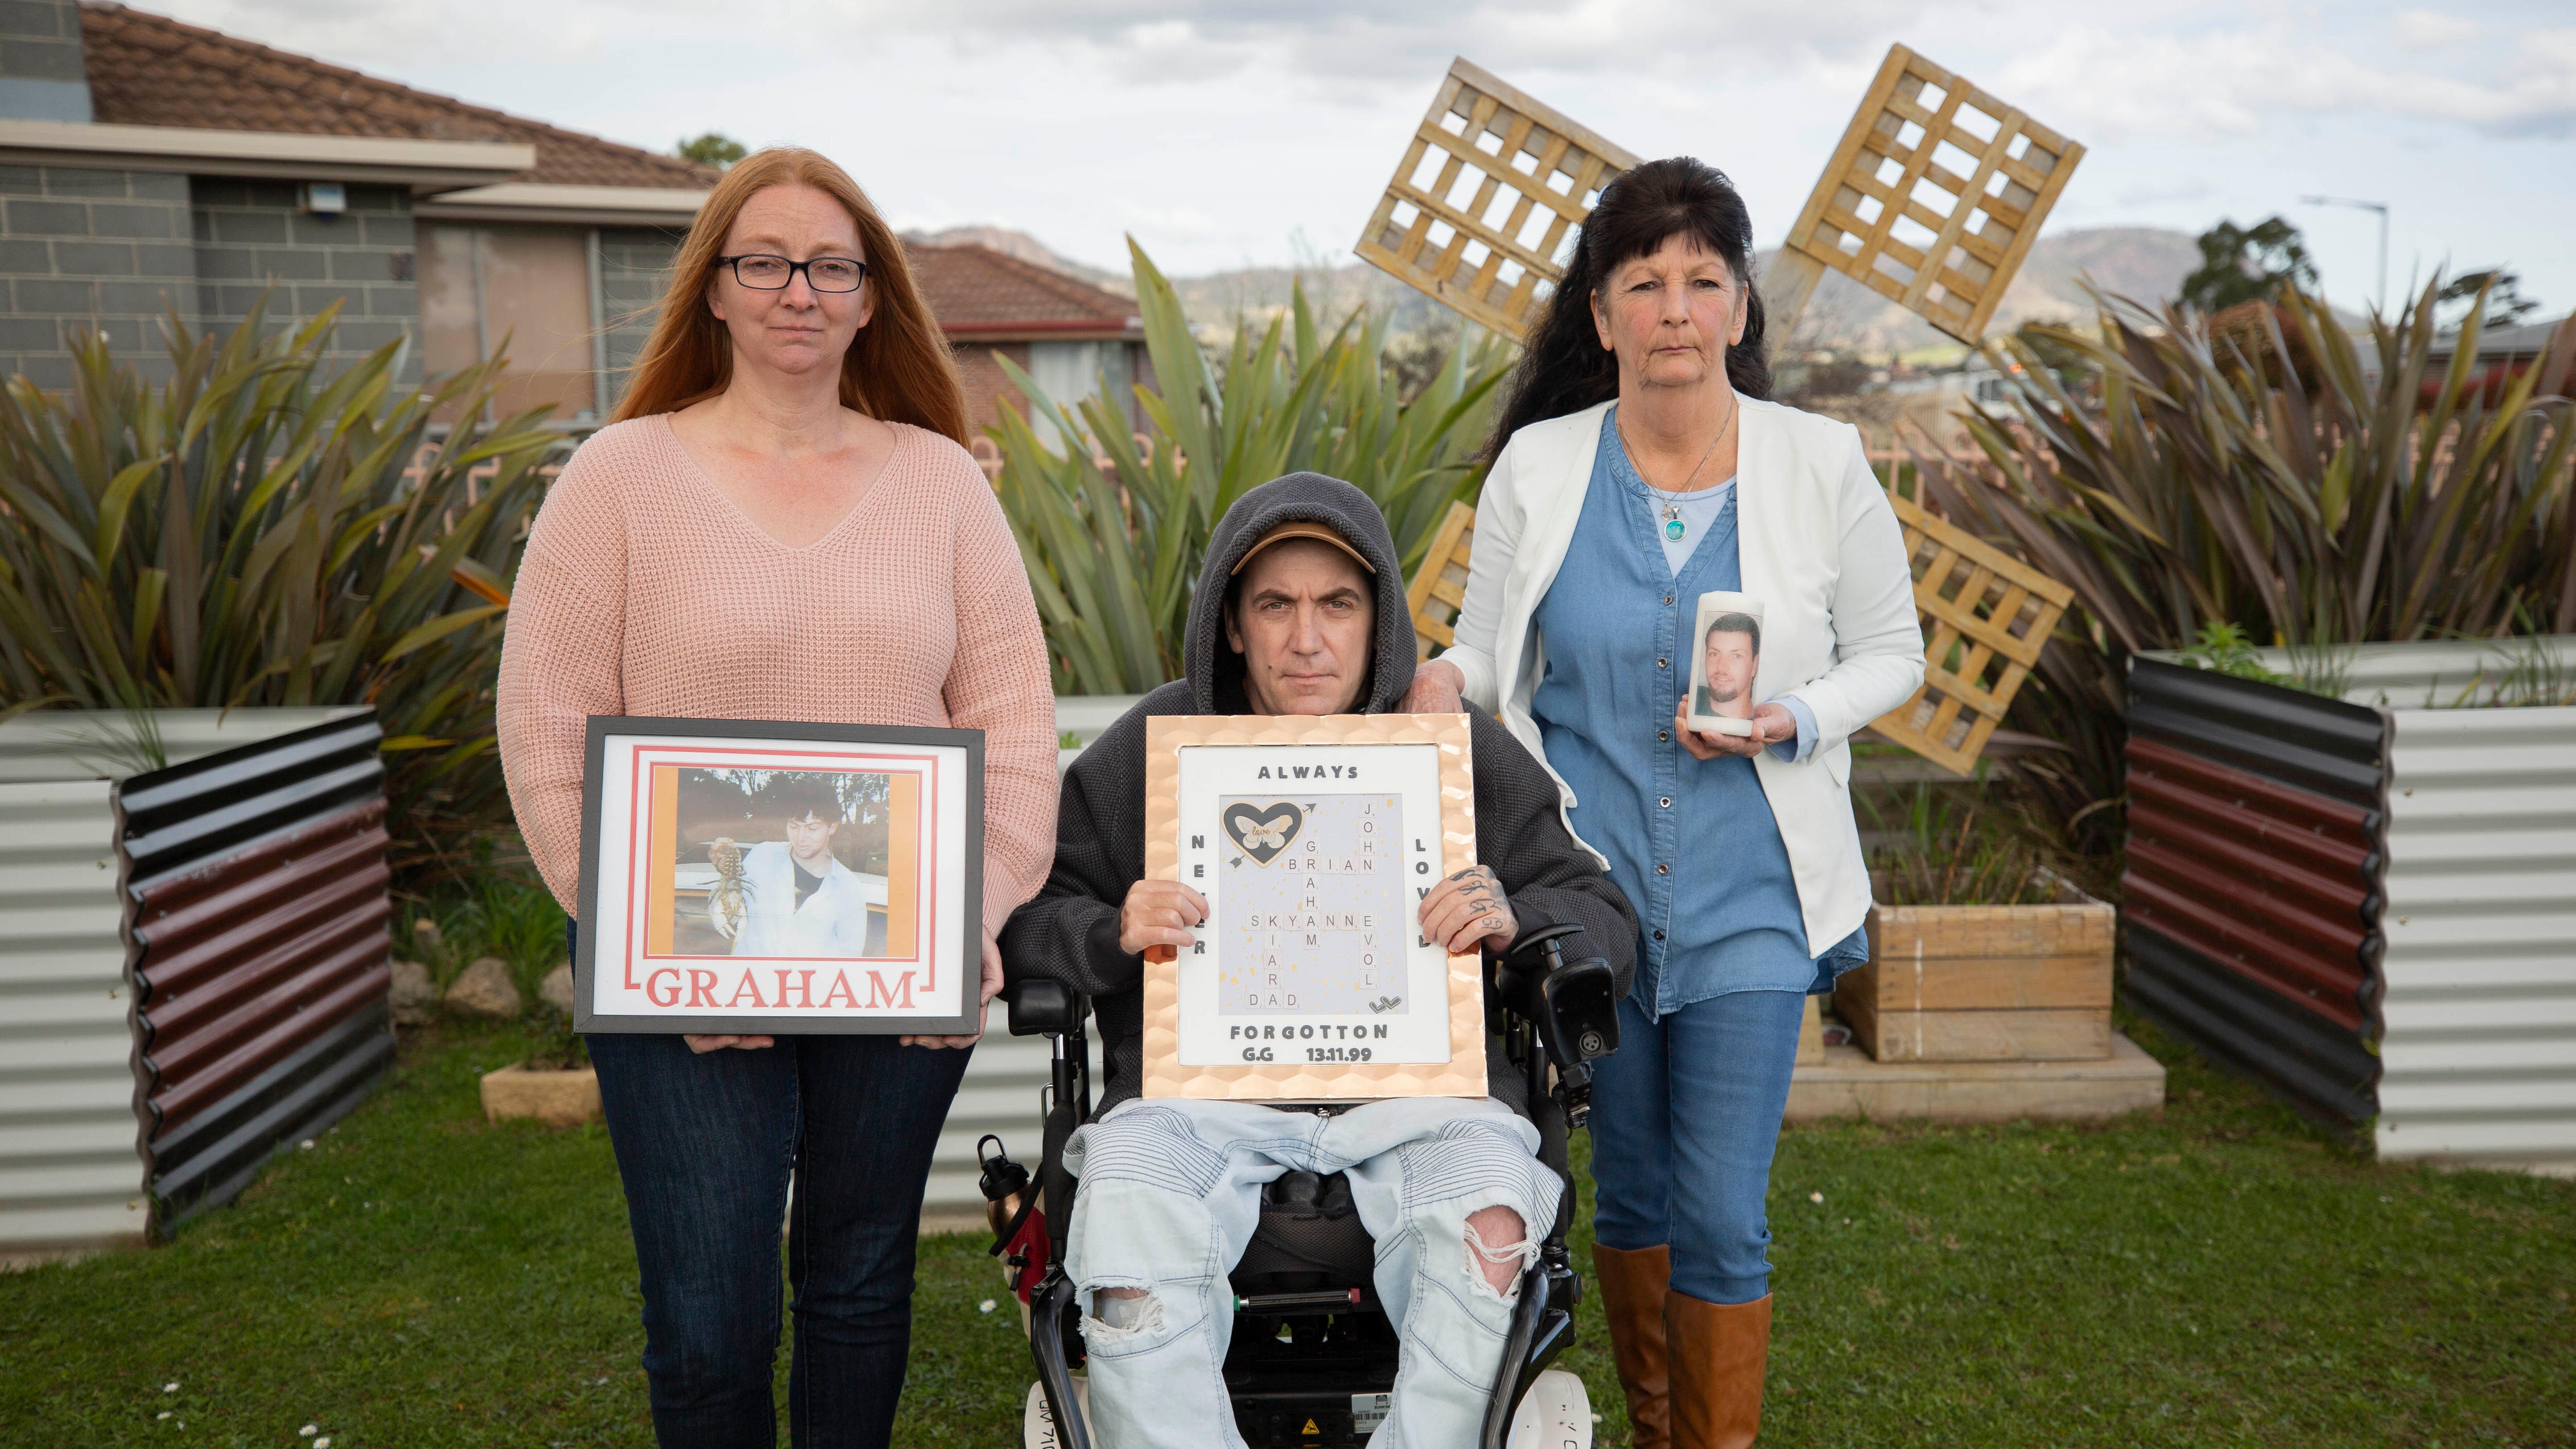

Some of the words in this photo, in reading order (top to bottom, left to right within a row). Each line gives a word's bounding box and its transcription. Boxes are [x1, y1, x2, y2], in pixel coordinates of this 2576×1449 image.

[1258, 765, 1358, 779] ALWAYS
[1252, 826, 1270, 836] love
[1364, 803, 1373, 870] JOHN
[1289, 859, 1371, 871] BRIAN
[1192, 835, 1206, 954] NEER
[1306, 841, 1319, 945] GRAHAM
[1415, 839, 1431, 948] LOVD
[1251, 916, 1371, 927] SKYANNE
[1268, 916, 1278, 1005] KIARA
[646, 968, 917, 1009] GRAHAM
[1250, 994, 1296, 1006] DAD
[1231, 1024, 1387, 1039] FORGOTTON
[1243, 1047, 1274, 1062] G.G
[1307, 1048, 1372, 1062] 13.11.99
